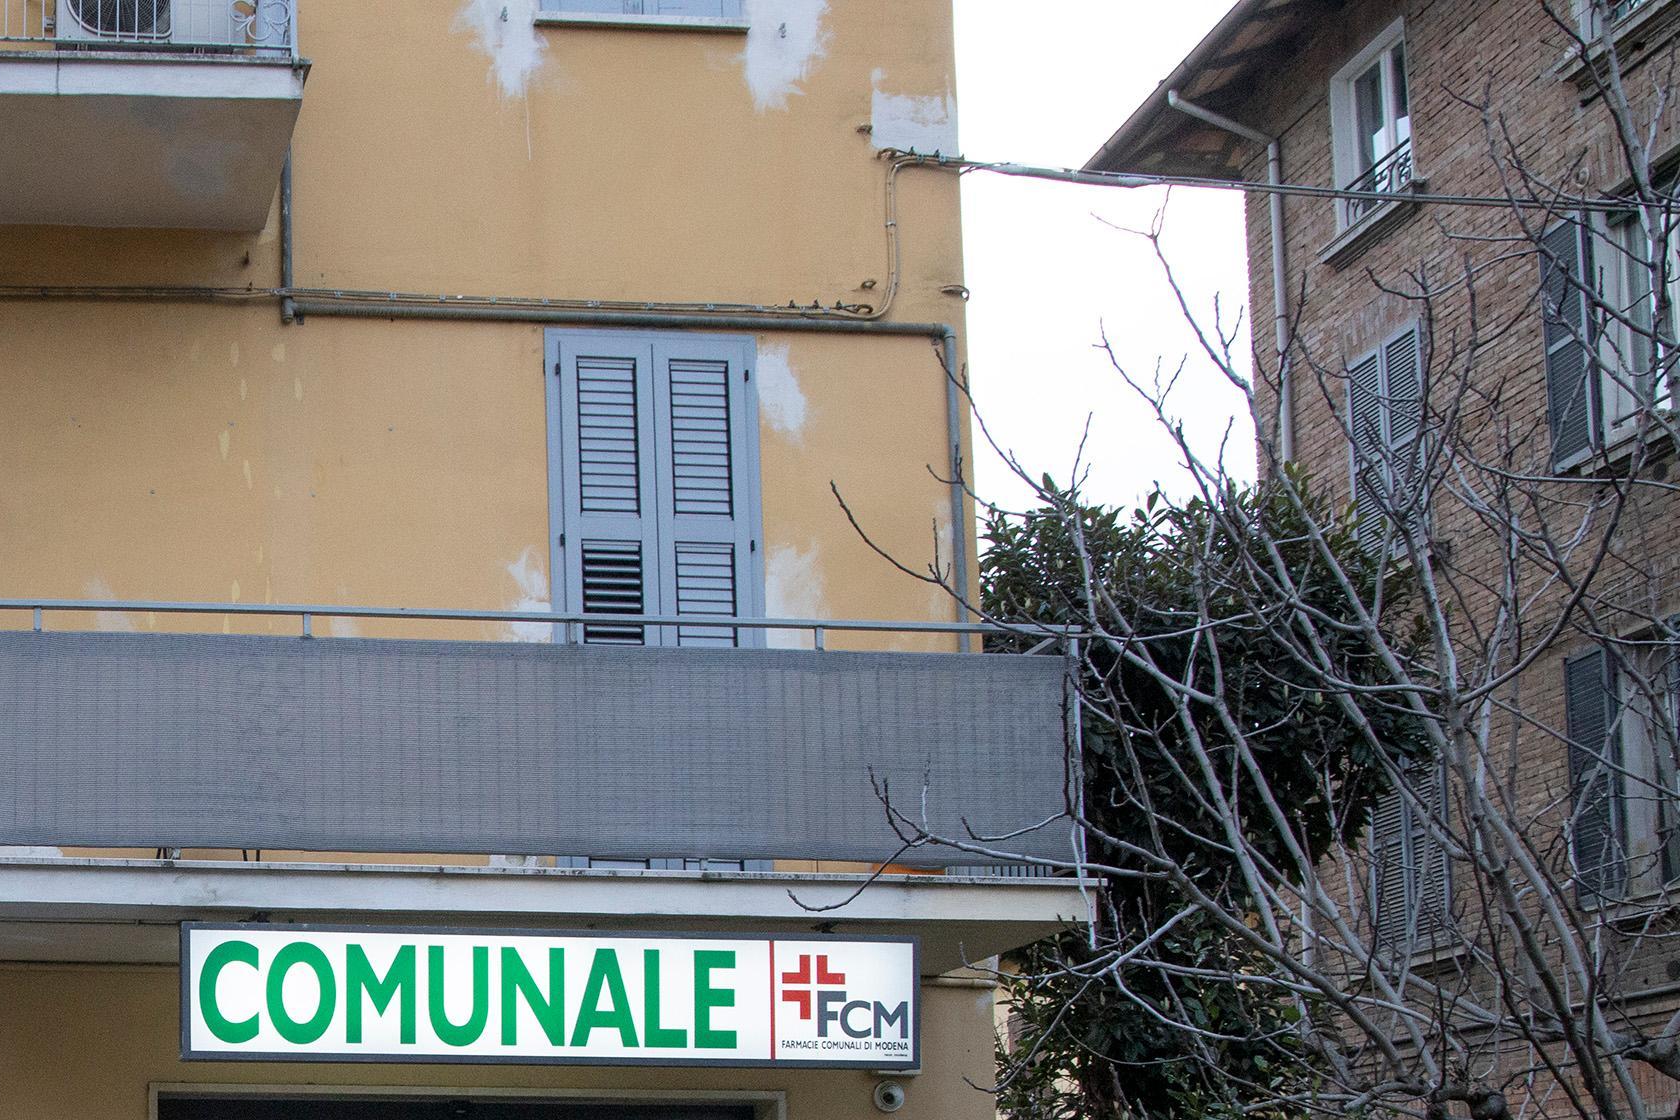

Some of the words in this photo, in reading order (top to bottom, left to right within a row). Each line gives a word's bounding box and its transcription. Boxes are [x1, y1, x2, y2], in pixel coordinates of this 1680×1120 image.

[199, 940, 737, 1049] COMUNALE
[817, 990, 909, 1039] FCM
[781, 1040, 819, 1049] FARMACIE
[821, 1041, 862, 1050] COMUNALI
[864, 1041, 872, 1050] DI
[874, 1042, 909, 1051] MODENA
